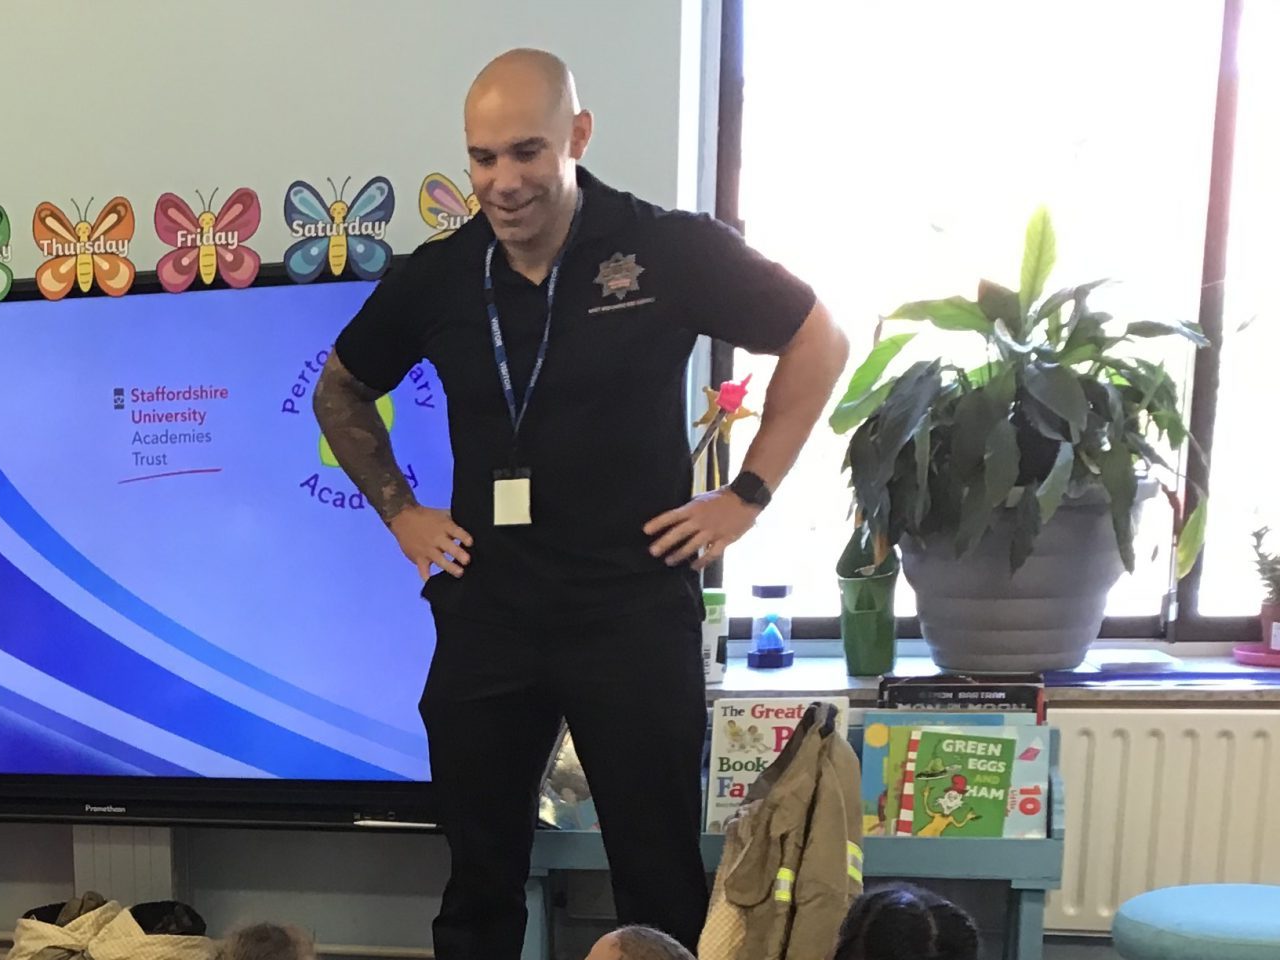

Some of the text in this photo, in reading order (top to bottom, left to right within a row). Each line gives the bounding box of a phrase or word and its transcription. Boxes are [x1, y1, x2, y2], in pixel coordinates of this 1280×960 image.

[291, 216, 387, 240] Saturday
[40, 236, 130, 258] Thursday
[176, 229, 239, 250] Friday
[281, 344, 336, 415] Perto
[131, 385, 229, 403] Staffordshire
[131, 408, 207, 426] University
[131, 429, 212, 445] Academies
[131, 451, 168, 466] Trust
[299, 464, 420, 510] Acady
[721, 704, 805, 720] The Great
[942, 739, 1002, 757] GREEN
[718, 757, 768, 772] Book
[967, 758, 1007, 773] EGGS
[973, 773, 1000, 785] AND
[964, 784, 1004, 800] HAM
[1019, 784, 1041, 816] 10
[85, 804, 126, 813] Promethean
